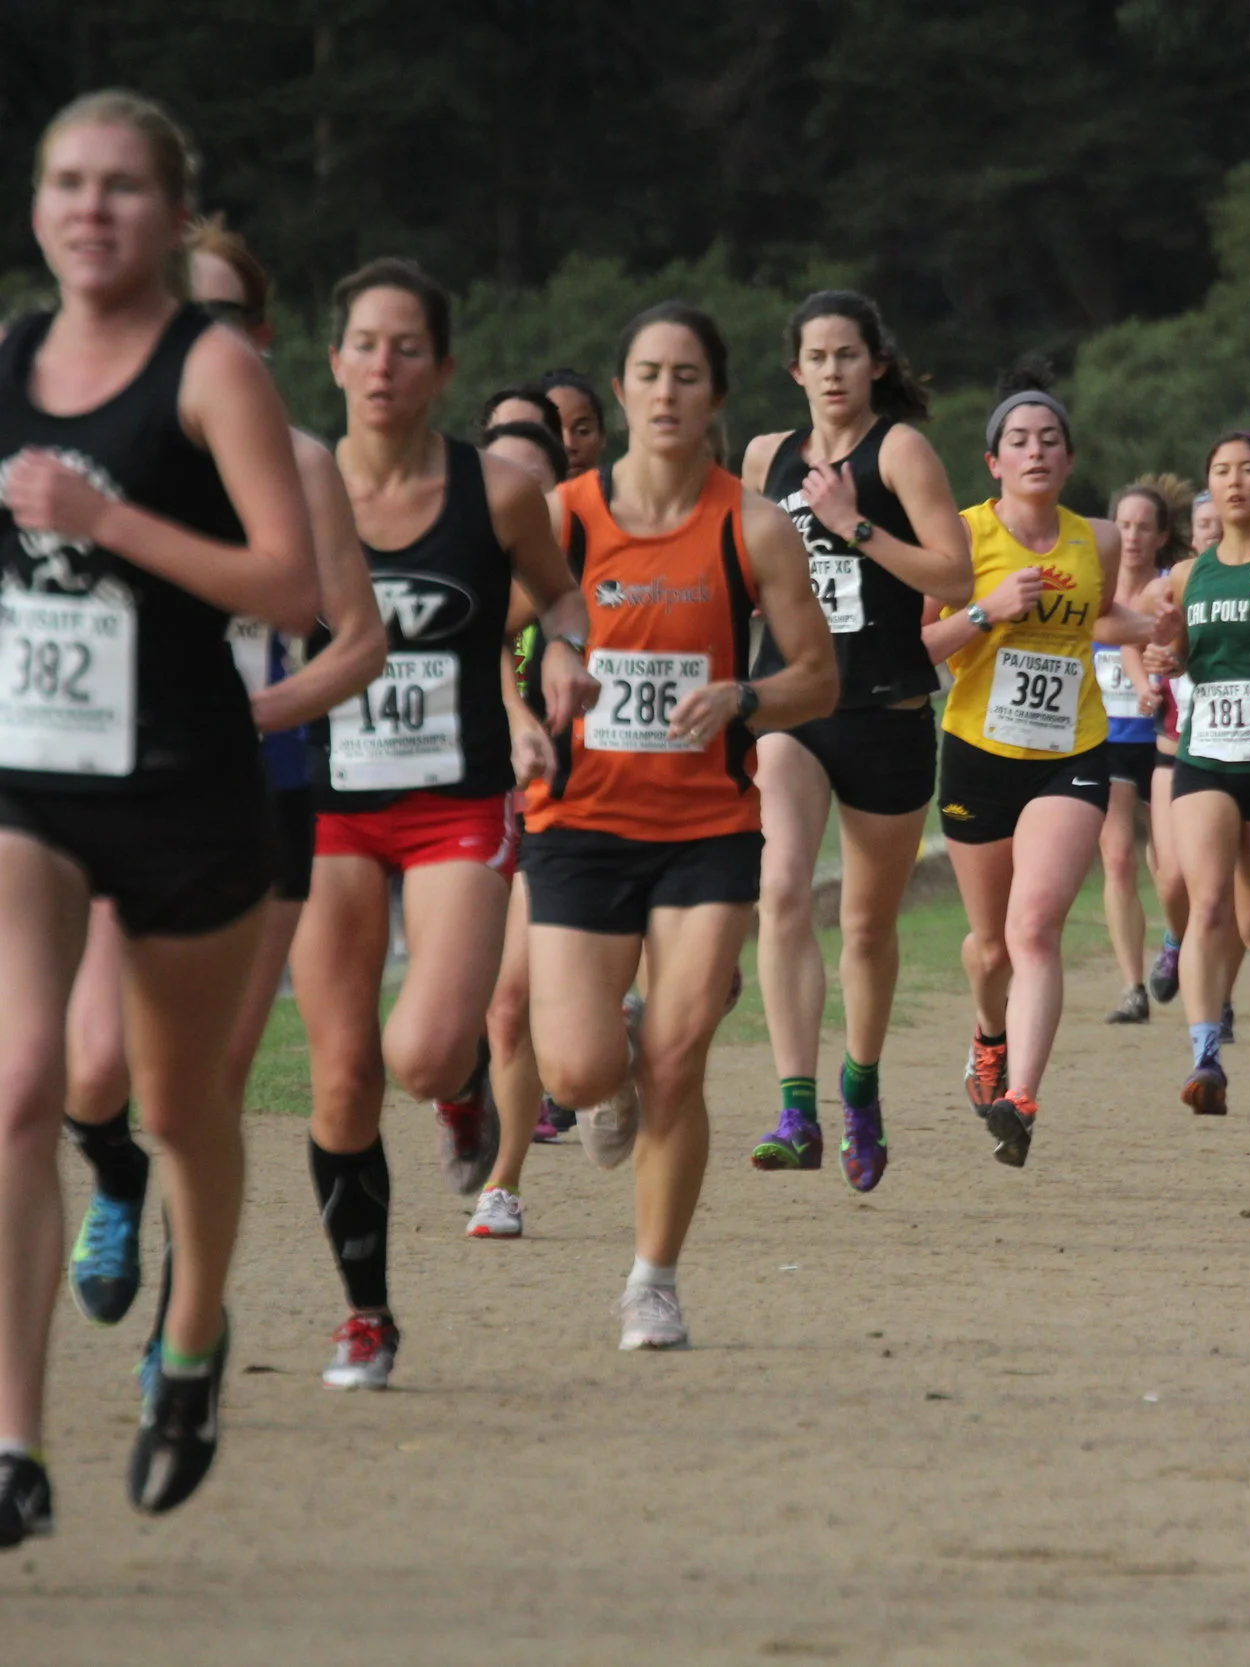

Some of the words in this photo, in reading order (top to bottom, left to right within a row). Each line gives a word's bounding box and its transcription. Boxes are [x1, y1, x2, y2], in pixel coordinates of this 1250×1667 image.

[1188, 602, 1207, 627] CAL
[1211, 599, 1249, 622] POLY
[679, 661, 700, 678] XC
[1003, 653, 1061, 673] PA/USATF
[1064, 661, 1079, 677] XC
[612, 680, 677, 727] 286
[1011, 671, 1063, 713] 392
[361, 684, 425, 734] 140
[1209, 698, 1245, 728] 181
